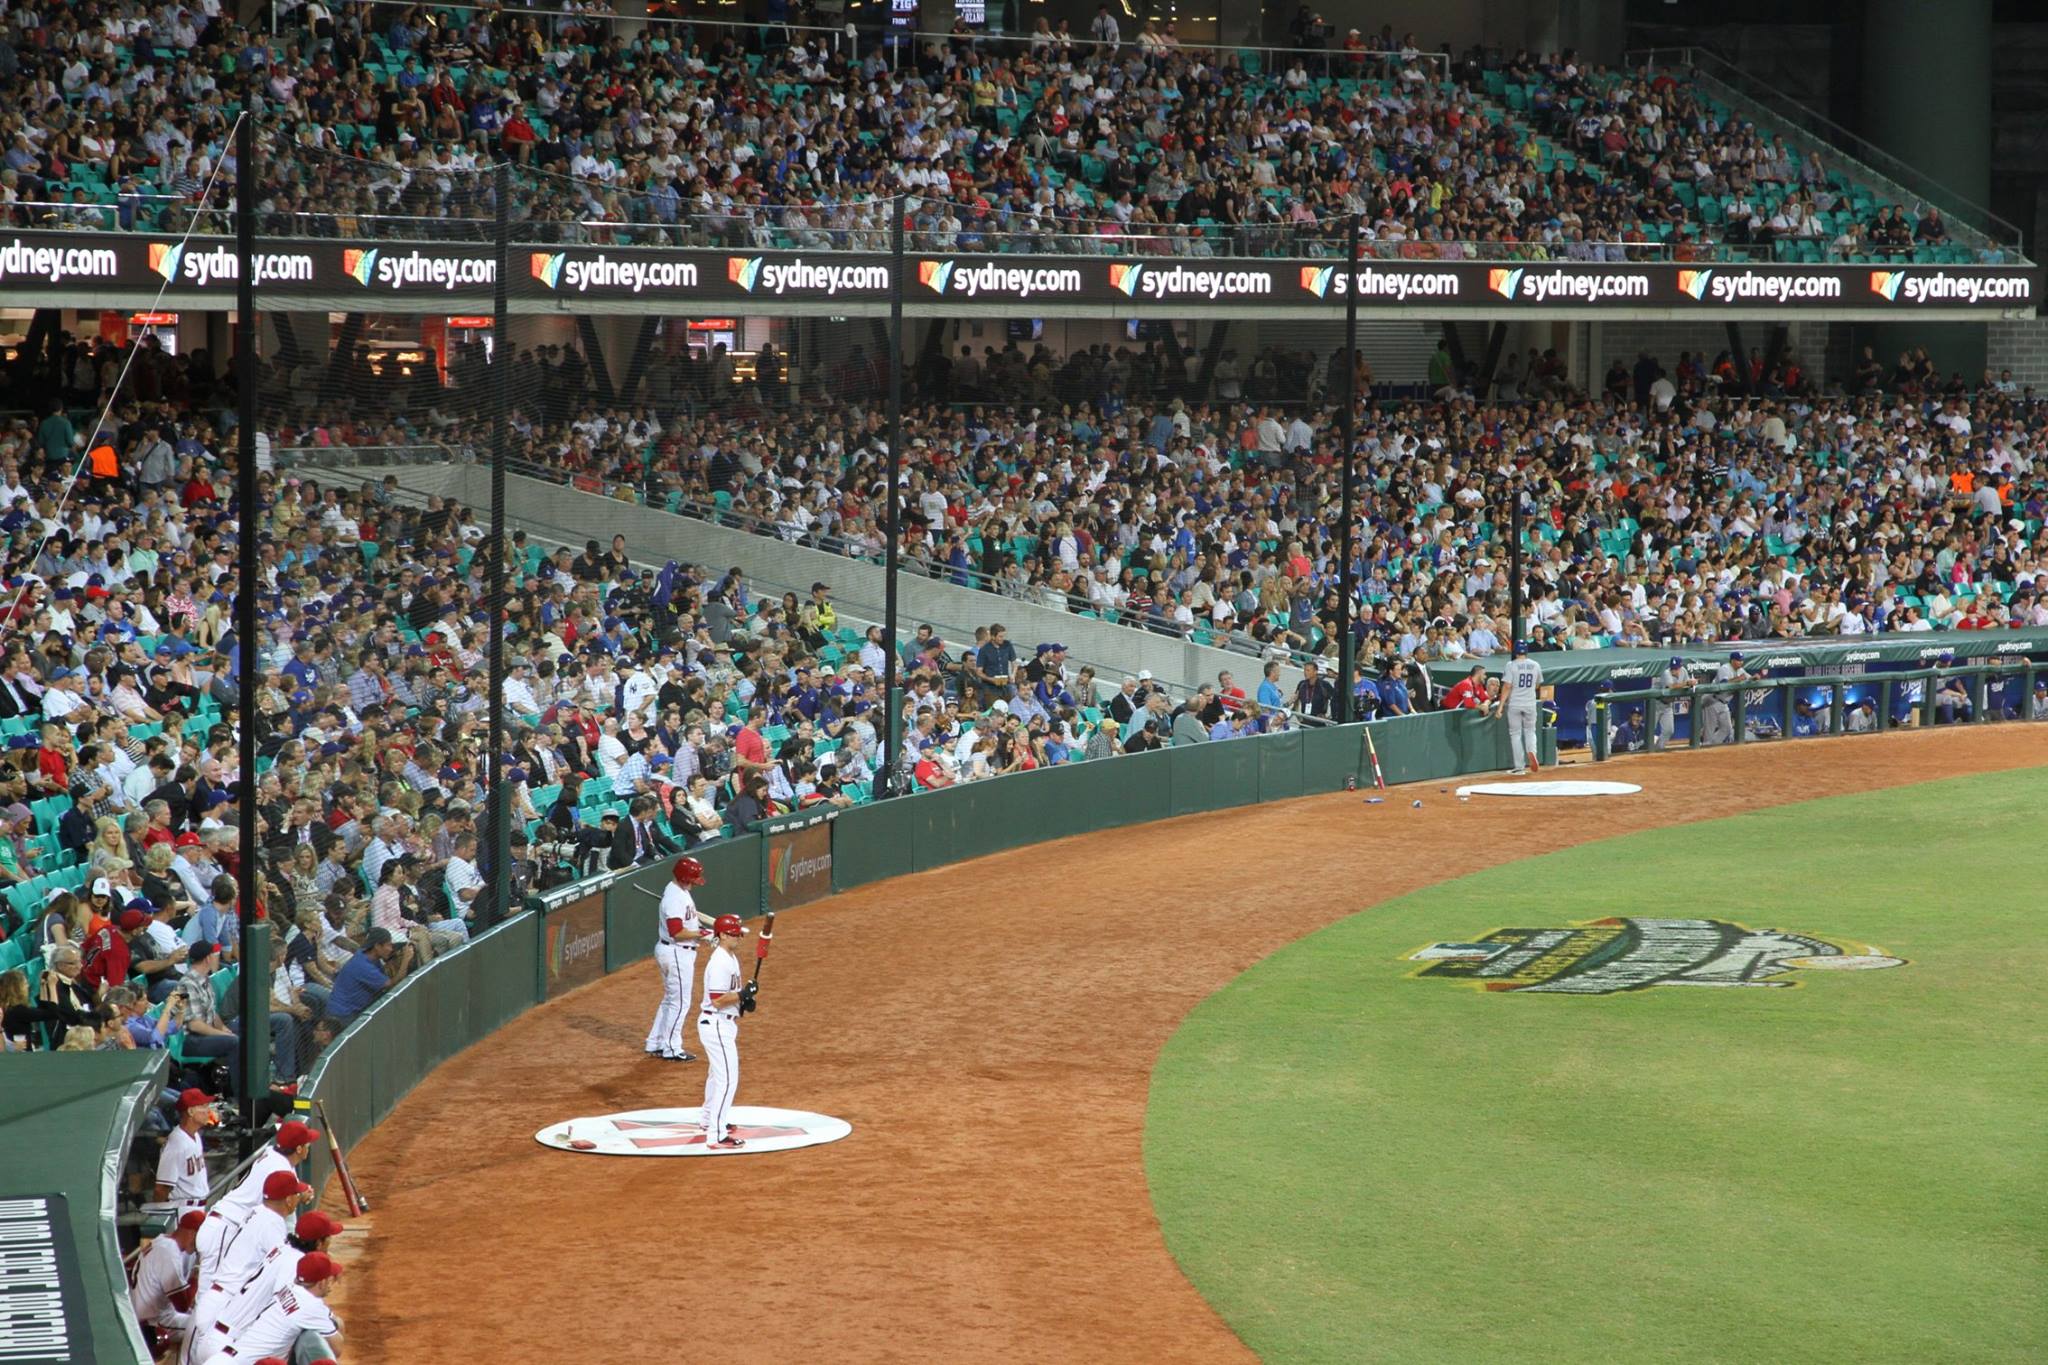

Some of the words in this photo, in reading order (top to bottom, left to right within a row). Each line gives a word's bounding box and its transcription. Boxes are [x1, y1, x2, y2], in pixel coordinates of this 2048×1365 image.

[184, 245, 313, 286] sydny.com
[565, 255, 698, 292] sydney.com
[762, 258, 889, 295] sydney.com
[954, 262, 1081, 298] sydney.com
[1142, 265, 1271, 299] sydney.com
[1334, 267, 1459, 301] sdney.com
[1523, 269, 1649, 302] sydney.com
[1712, 270, 1841, 303] sydney.com
[1904, 272, 2030, 304] sydney.com
[1768, 656, 1802, 667] sydney.com
[1846, 651, 1880, 663] sydney.com
[1998, 641, 2033, 652] sydney.com
[1518, 673, 1533, 688] 88
[1610, 667, 1643, 678] sydney.com
[1686, 661, 1721, 672] sydney.com
[789, 854, 832, 883] sydney.com
